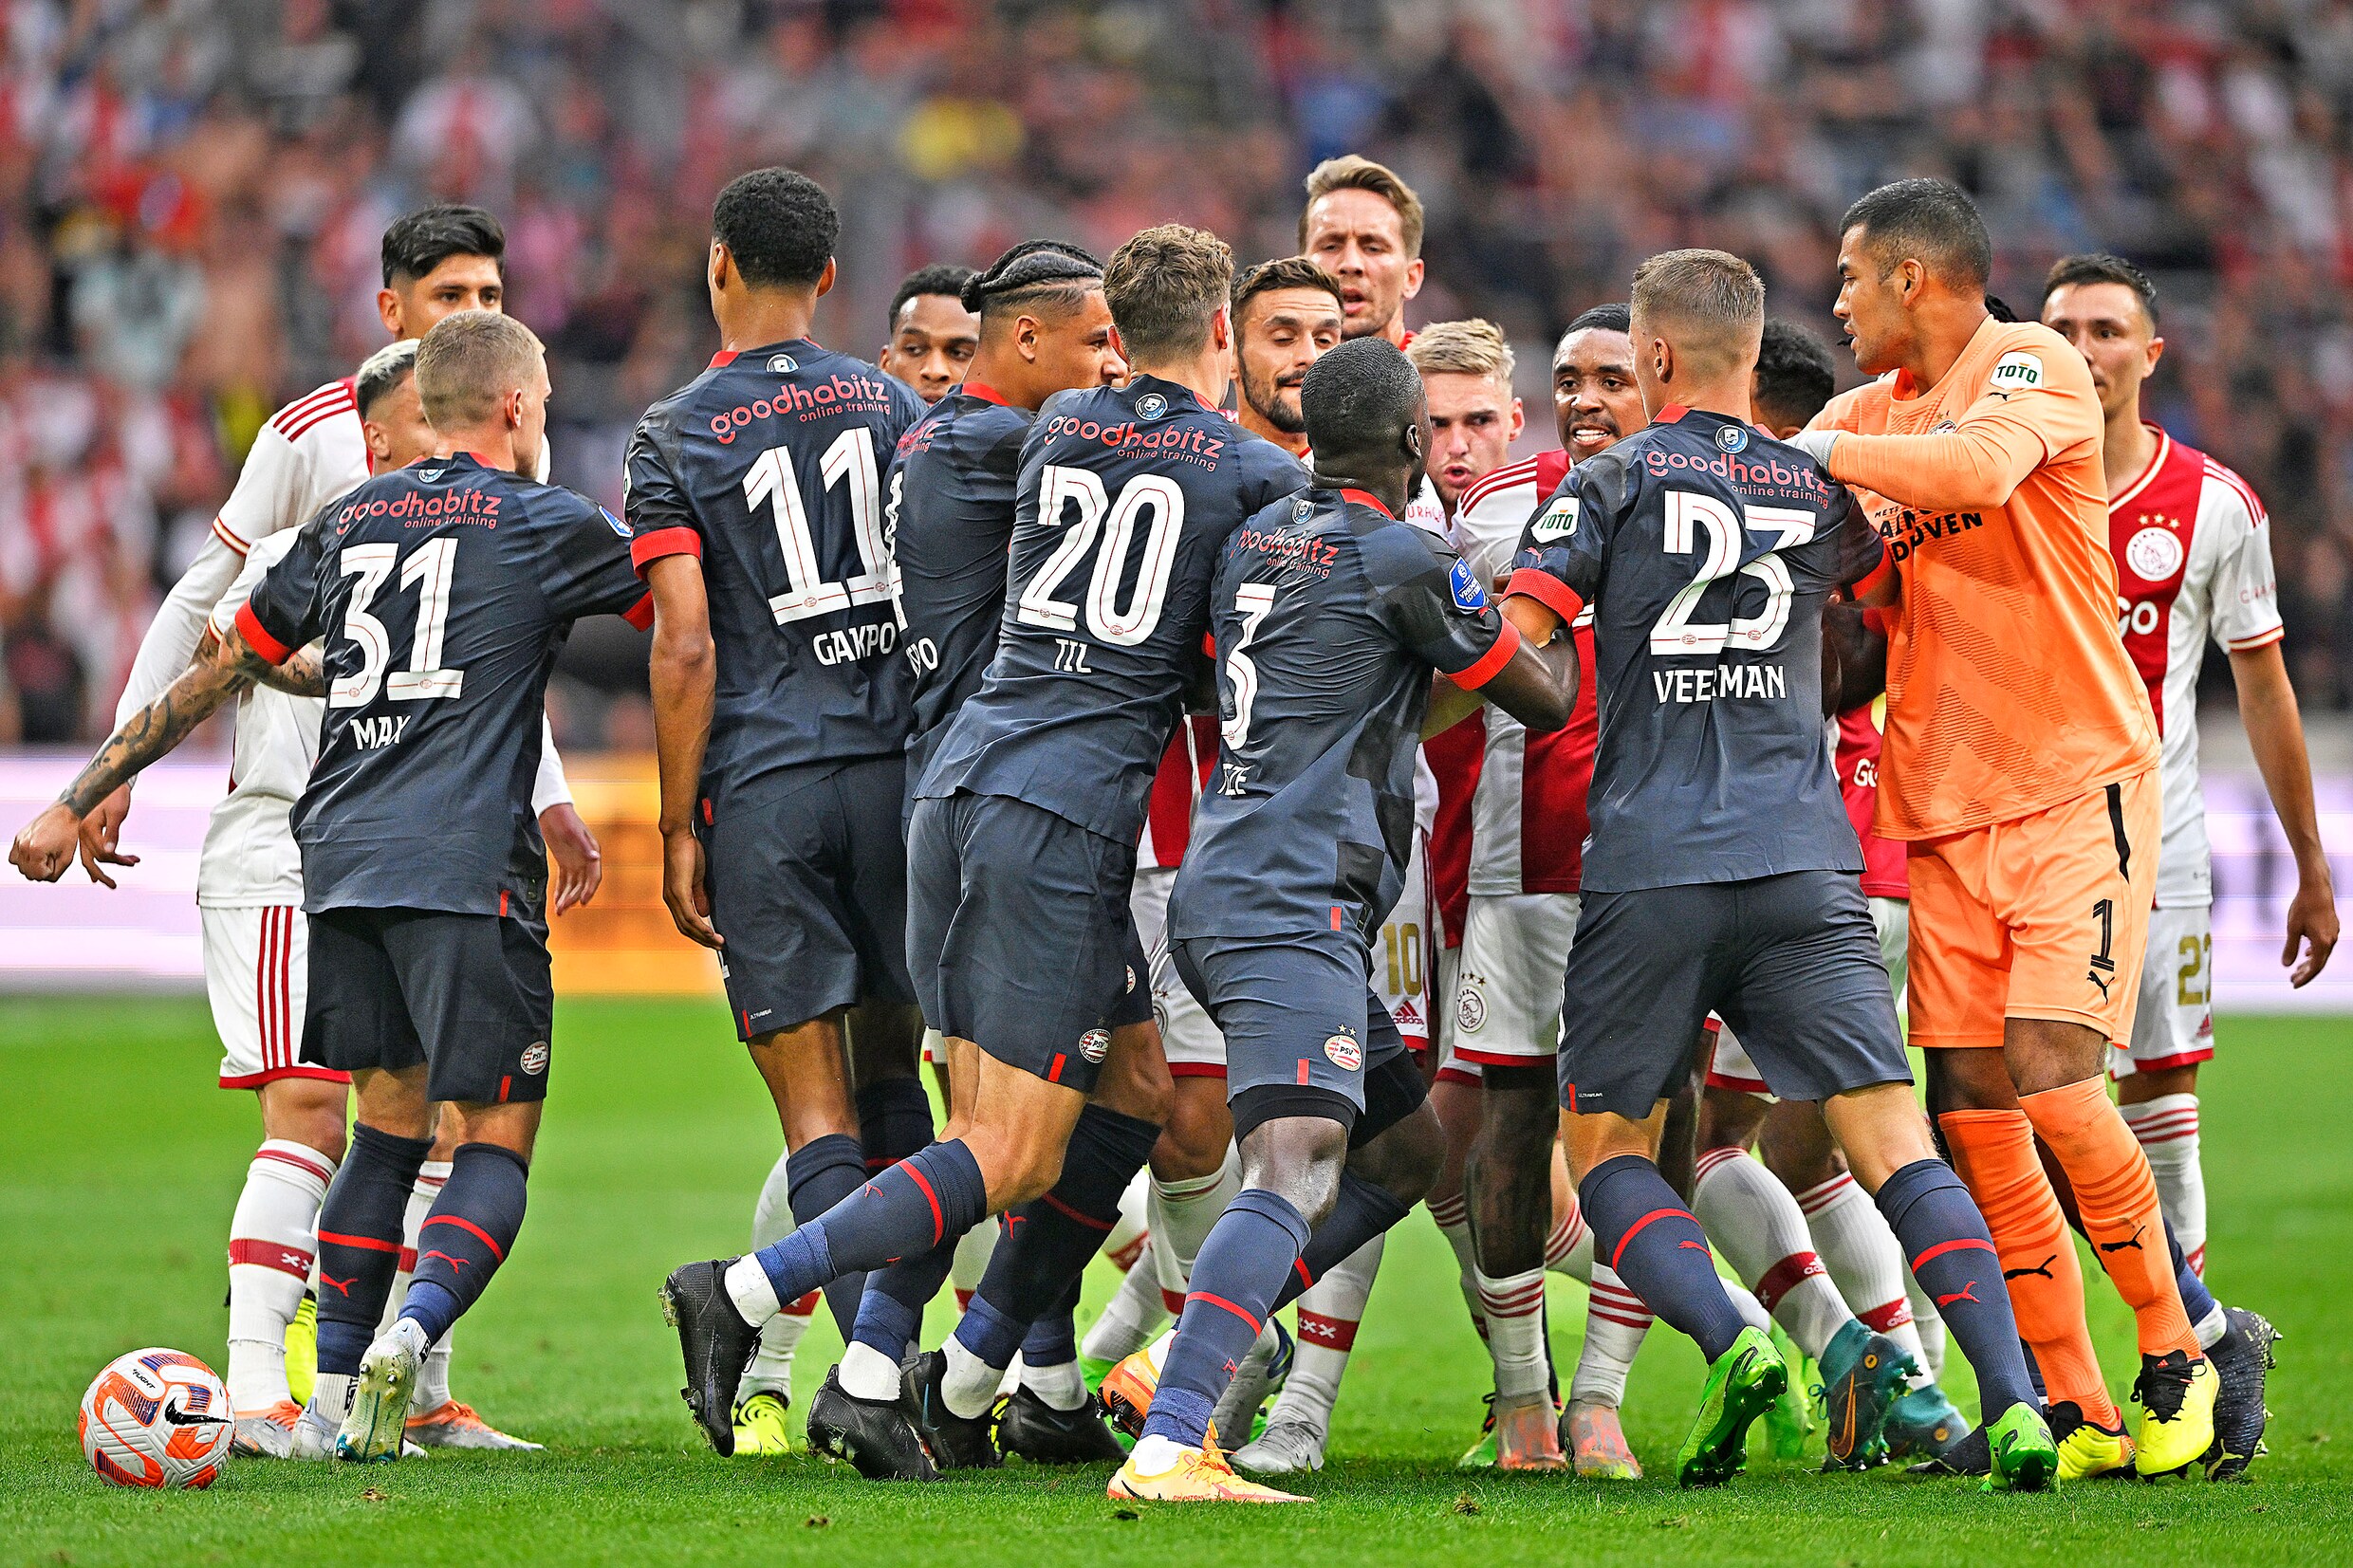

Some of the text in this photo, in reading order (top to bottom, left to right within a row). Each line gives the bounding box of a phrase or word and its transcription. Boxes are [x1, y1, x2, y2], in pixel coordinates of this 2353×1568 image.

[1997, 365, 2038, 383] TOTO
[711, 374, 889, 445] goodhabitz
[799, 400, 891, 423] online training
[1044, 415, 1225, 459] goodhabitz
[1117, 449, 1217, 471] online training
[1646, 451, 1829, 496] goodhabitz
[337, 488, 503, 536] goodhabitz
[1732, 484, 1829, 510] online training
[404, 513, 497, 529] online training
[742, 426, 894, 626] 11
[1540, 514, 1574, 530] TOTO
[1017, 464, 1185, 647] 20
[1290, 560, 1330, 579] training
[1650, 490, 1816, 656] 23
[329, 537, 464, 709] 31
[813, 621, 896, 666] GAKPO
[1054, 638, 1091, 673] TIL
[1221, 581, 1277, 750] 3
[1653, 664, 1787, 704] VEEMAN
[350, 714, 411, 750] MAX
[2090, 898, 2115, 972] 1
[1382, 922, 1421, 996] 10
[1393, 1015, 1424, 1025] adidas
[1340, 1045, 1354, 1056] PSV
